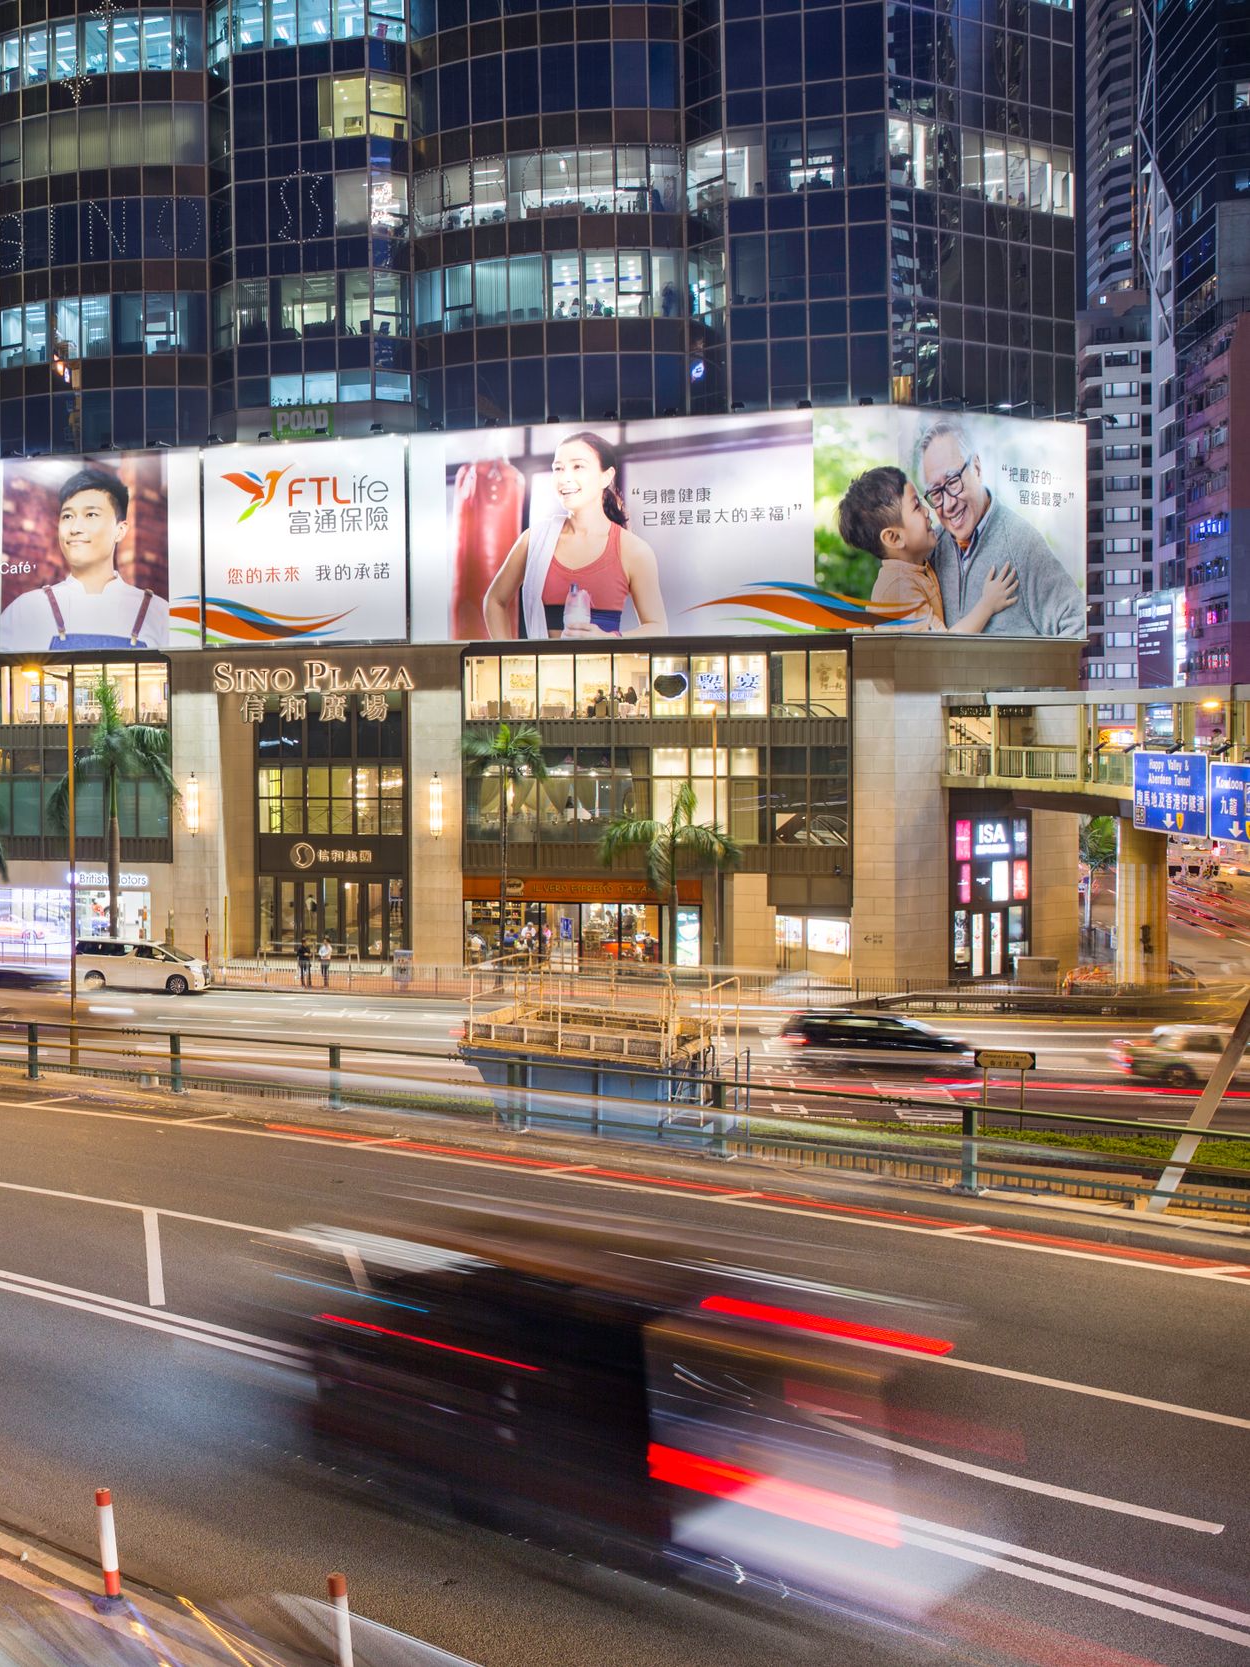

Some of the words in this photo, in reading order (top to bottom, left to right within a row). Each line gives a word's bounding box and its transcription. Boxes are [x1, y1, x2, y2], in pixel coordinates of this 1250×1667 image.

[276, 409, 328, 431] POAD
[288, 475, 389, 507] FTLife
[288, 506, 389, 534] 富通保險
[228, 566, 300, 585] 您的未來
[315, 562, 390, 582] 我的承諾
[214, 662, 296, 692] SINO
[304, 660, 415, 693] PLAZA
[240, 694, 389, 723] 信和廣場
[1149, 759, 1164, 772] Happy
[1167, 759, 1182, 773] Valley
[1184, 760, 1189, 771] &
[1148, 773, 1171, 785] Aberdeen
[1174, 774, 1191, 787] Tunnel
[1215, 775, 1244, 791] Kowloon
[1136, 790, 1205, 813] 跑馬地及香港仔隧道
[1220, 796, 1238, 816] 九龍
[979, 823, 1006, 843] ISA
[317, 849, 372, 863] 信和集團
[79, 873, 108, 884] British
